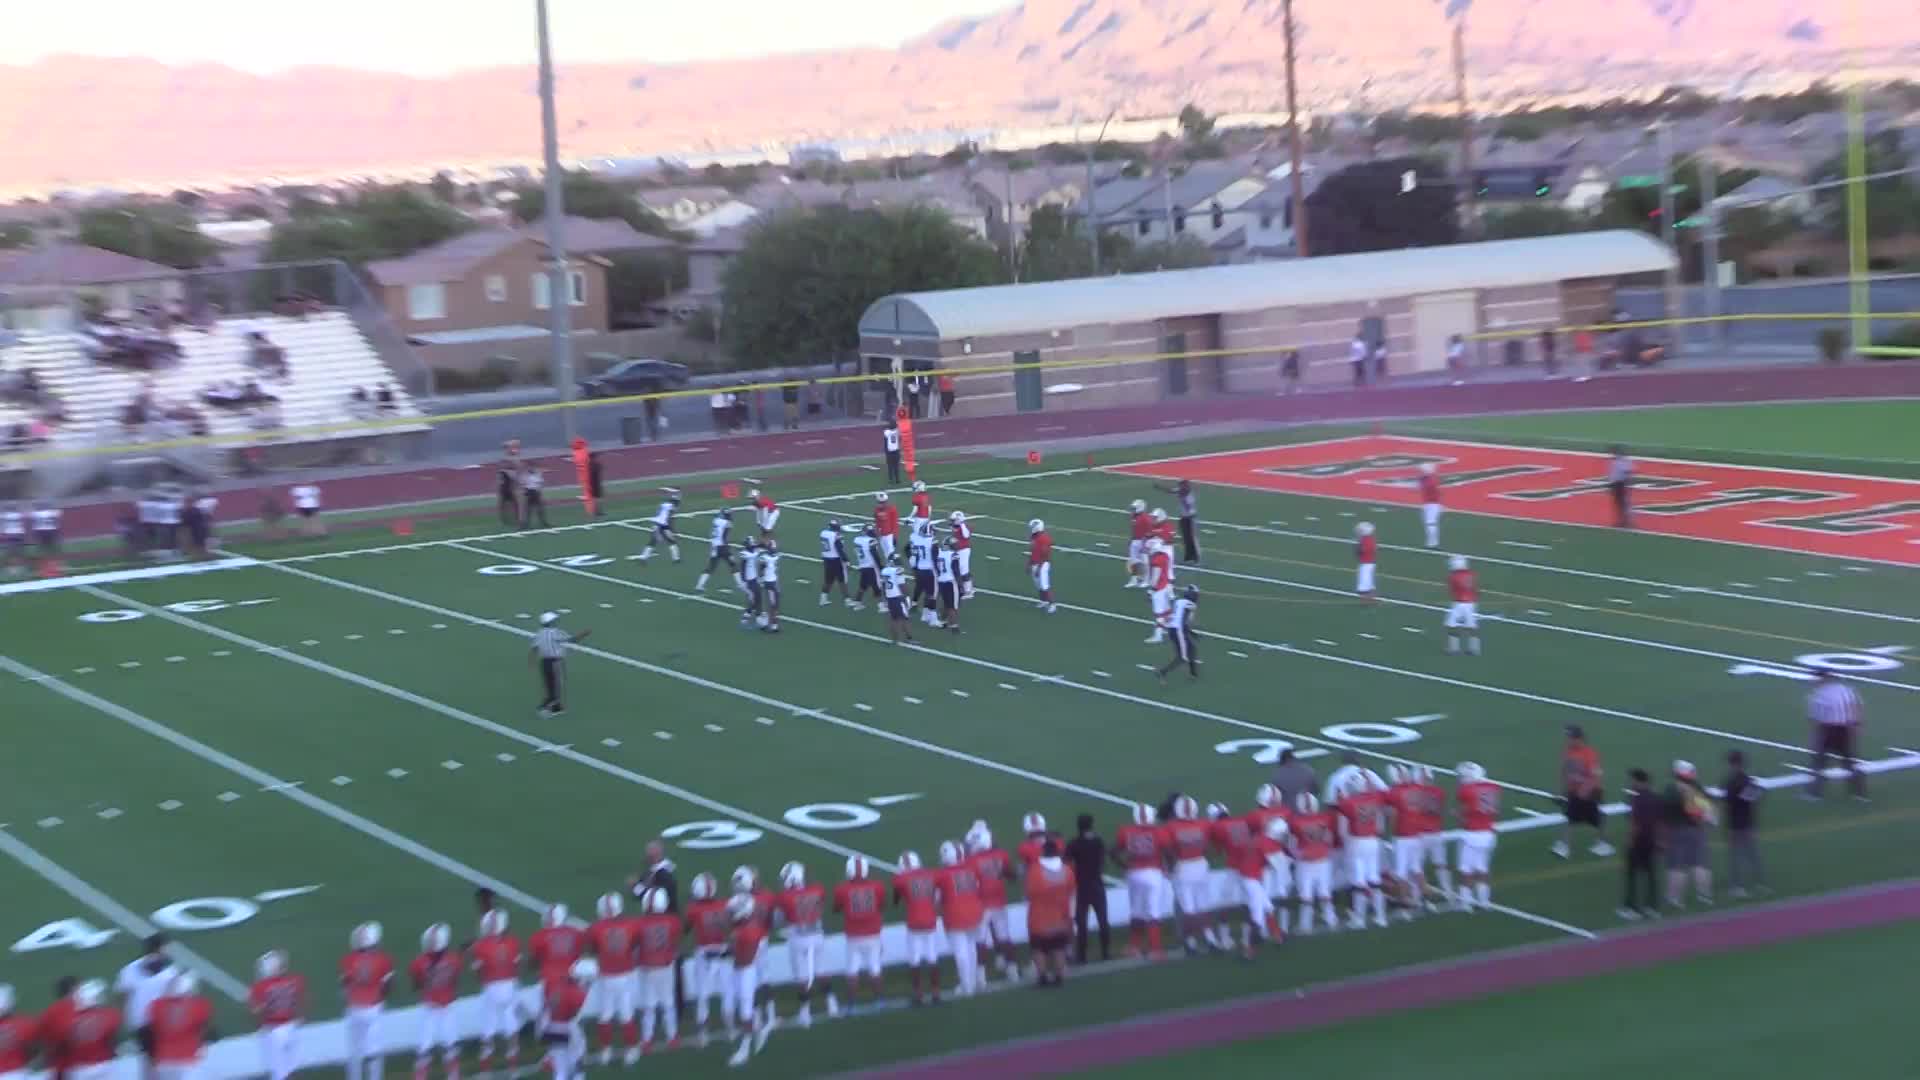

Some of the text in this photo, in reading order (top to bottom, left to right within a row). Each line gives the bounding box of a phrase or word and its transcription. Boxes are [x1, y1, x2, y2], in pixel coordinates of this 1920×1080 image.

[1726, 652, 1905, 681] 10
[1213, 722, 1423, 765] 20
[657, 802, 882, 850] 30
[8, 896, 262, 953] 40
